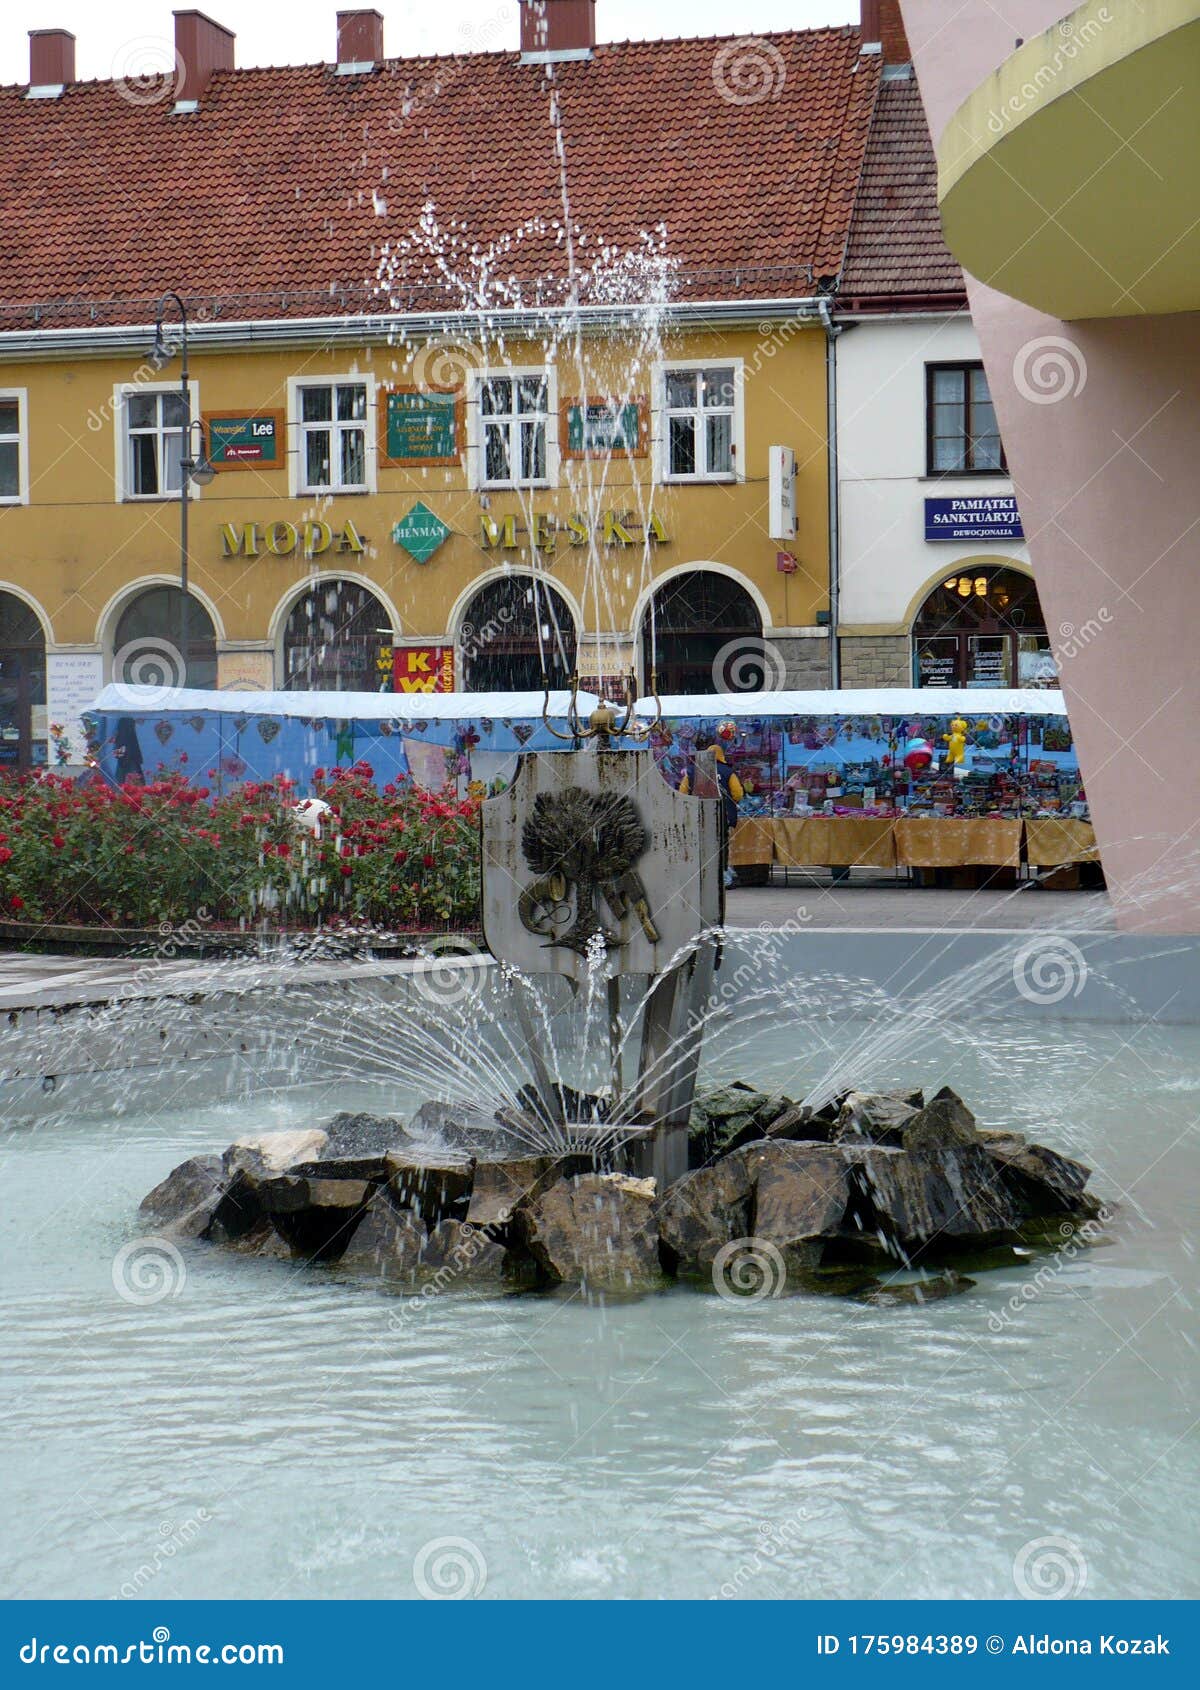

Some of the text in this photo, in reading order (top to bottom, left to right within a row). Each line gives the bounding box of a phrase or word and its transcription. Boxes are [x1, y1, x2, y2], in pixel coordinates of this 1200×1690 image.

[252, 423, 274, 436] Lee
[951, 500, 1014, 511] PAMIĄTKI
[933, 512, 1022, 523] SANKTUARYJN
[219, 510, 670, 557] MODA MĘSKA
[397, 527, 446, 537] HENMAN
